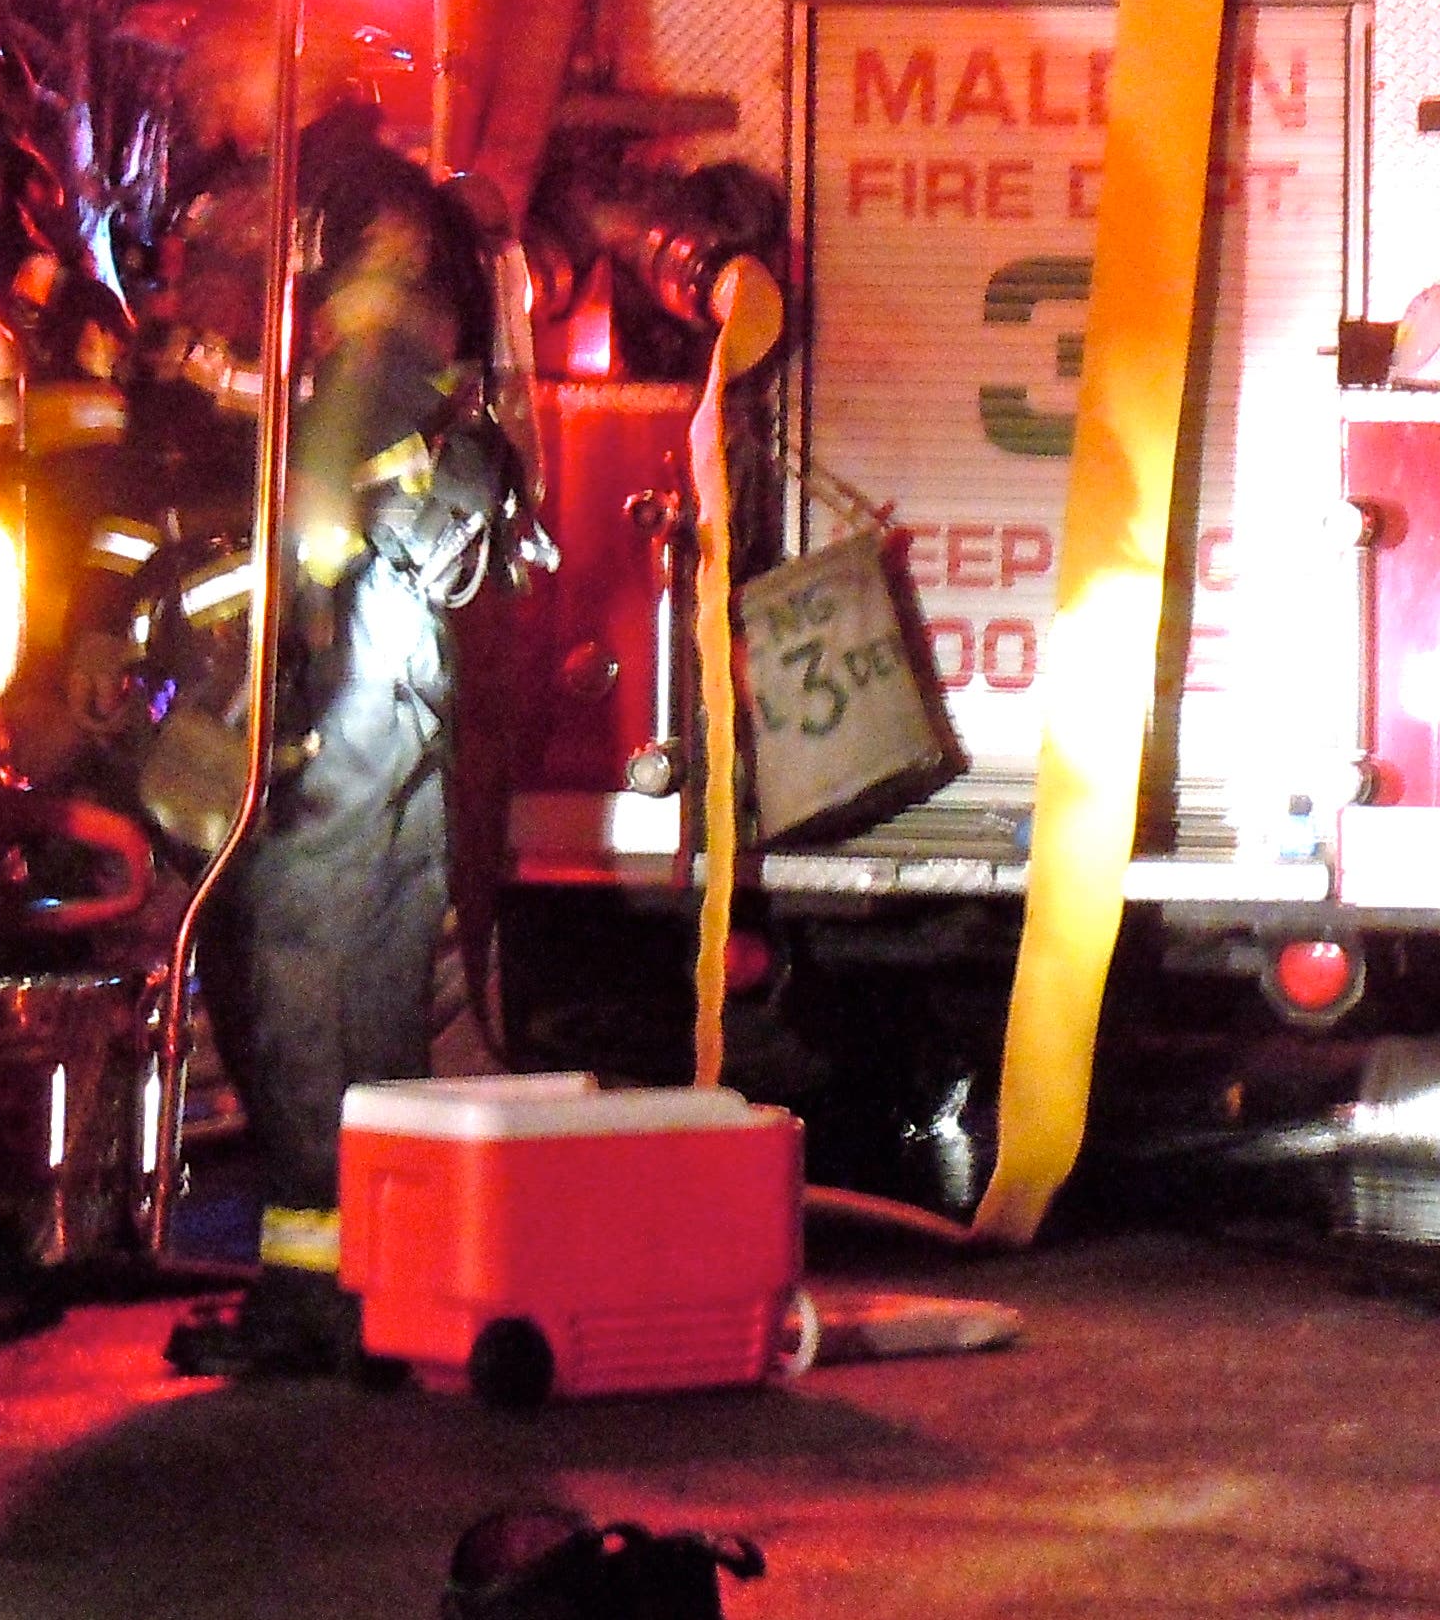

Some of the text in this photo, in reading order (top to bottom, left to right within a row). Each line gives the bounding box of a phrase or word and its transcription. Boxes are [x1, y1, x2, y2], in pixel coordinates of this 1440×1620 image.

[851, 46, 1308, 128] MALN
[846, 160, 1310, 220] FIRE DPT.
[896, 523, 1054, 587] EEP
[781, 636, 849, 738] 3
